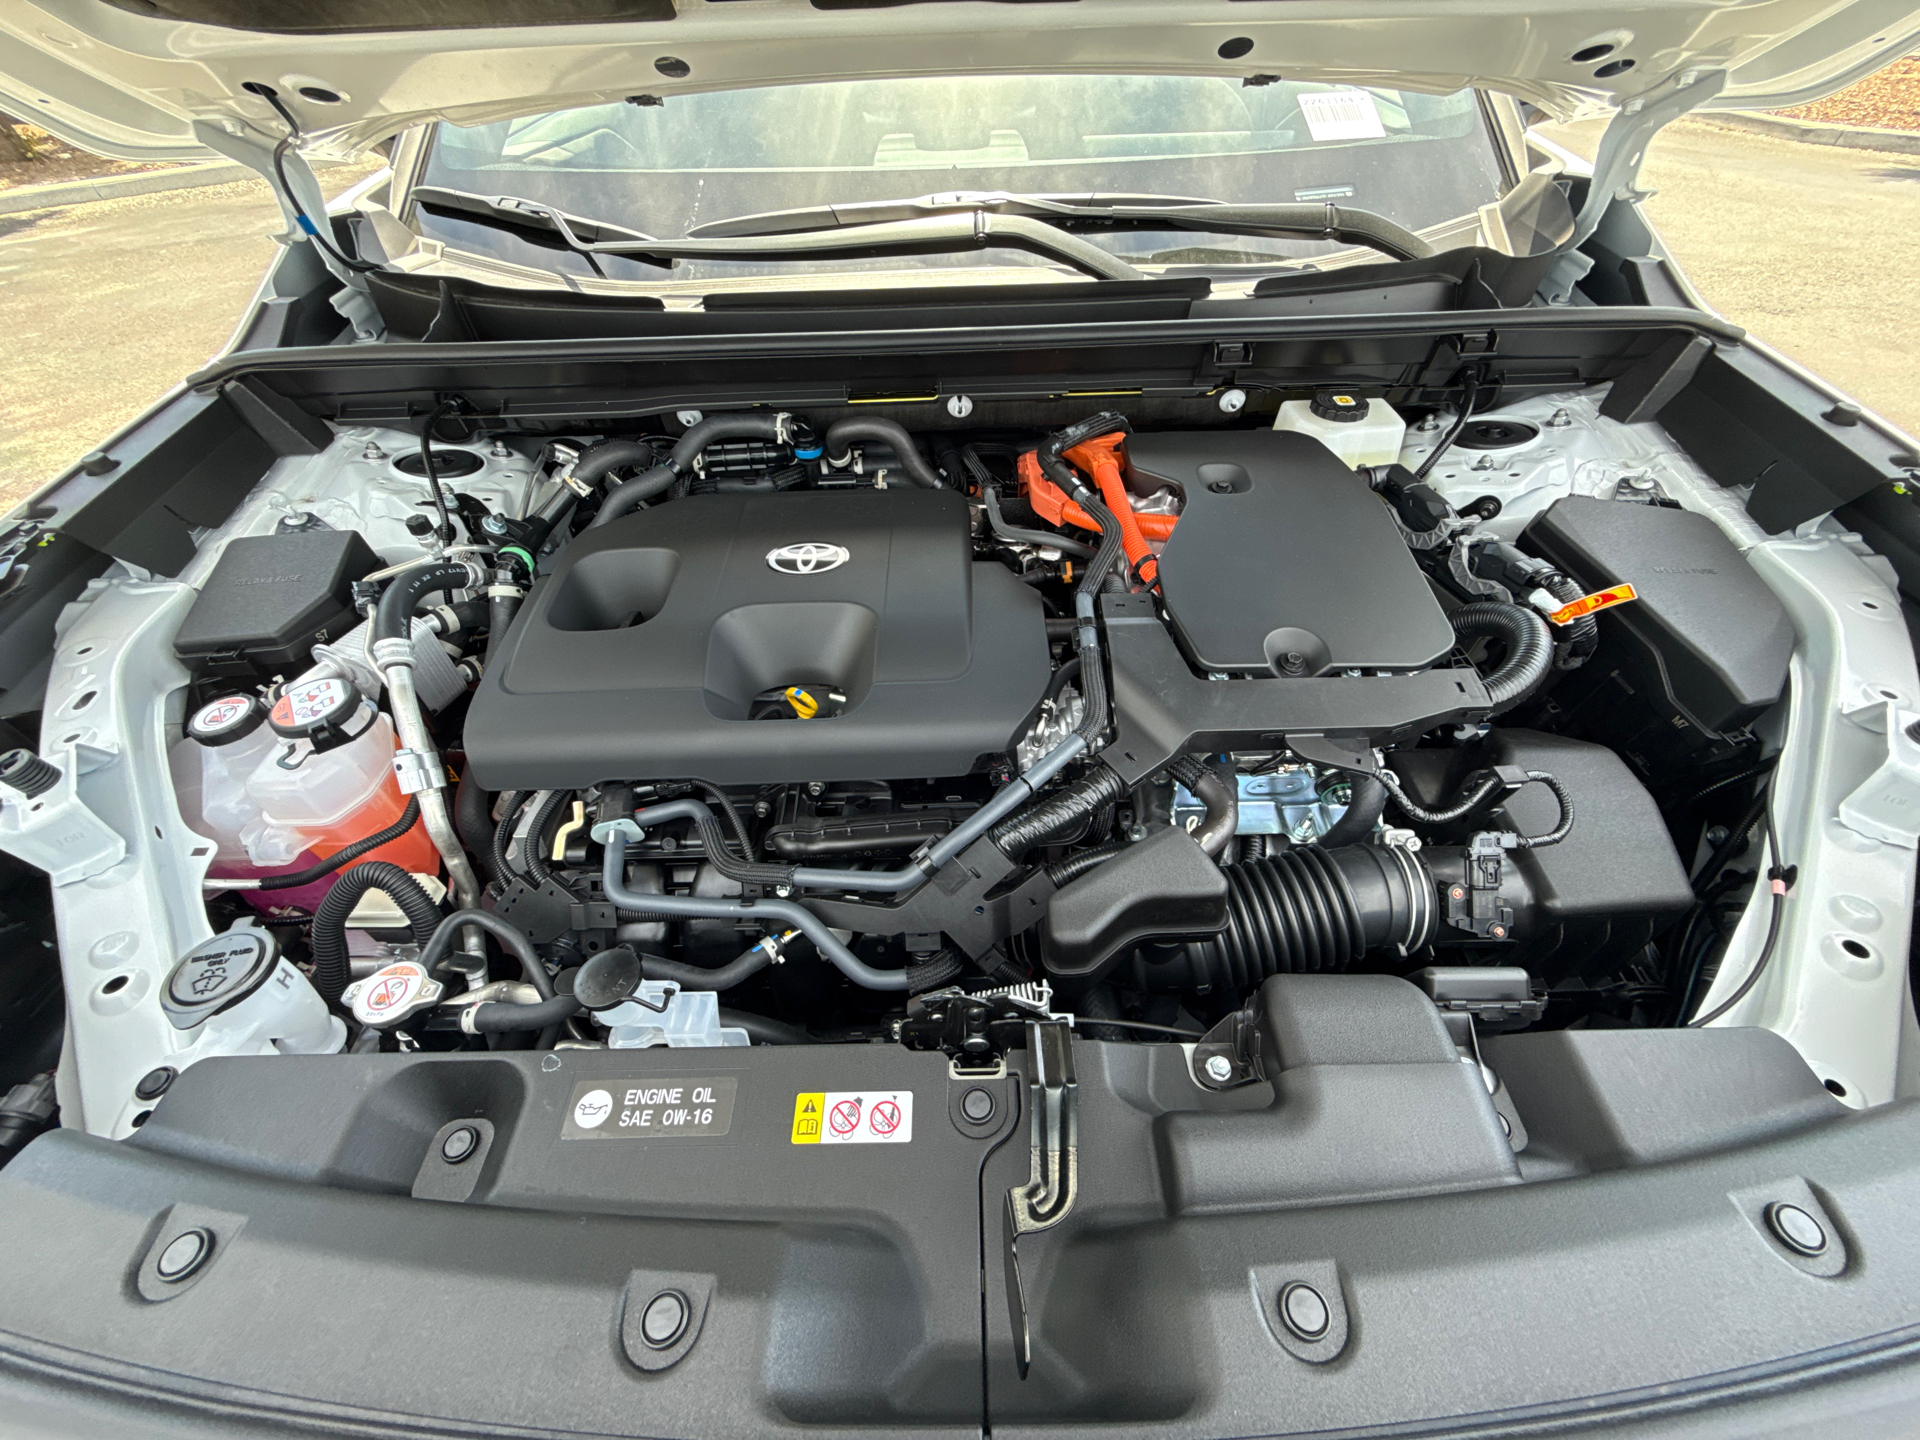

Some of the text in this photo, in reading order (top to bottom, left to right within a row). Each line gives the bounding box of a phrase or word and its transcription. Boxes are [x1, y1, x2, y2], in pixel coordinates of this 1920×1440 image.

[315, 628, 329, 642] S7
[1671, 714, 1690, 729] M7
[191, 947, 254, 963] WASHER FLUID
[207, 957, 231, 967] ONLY
[624, 1087, 717, 1105] ENGINE OIL
[618, 1108, 713, 1127] SAE 0W-16
